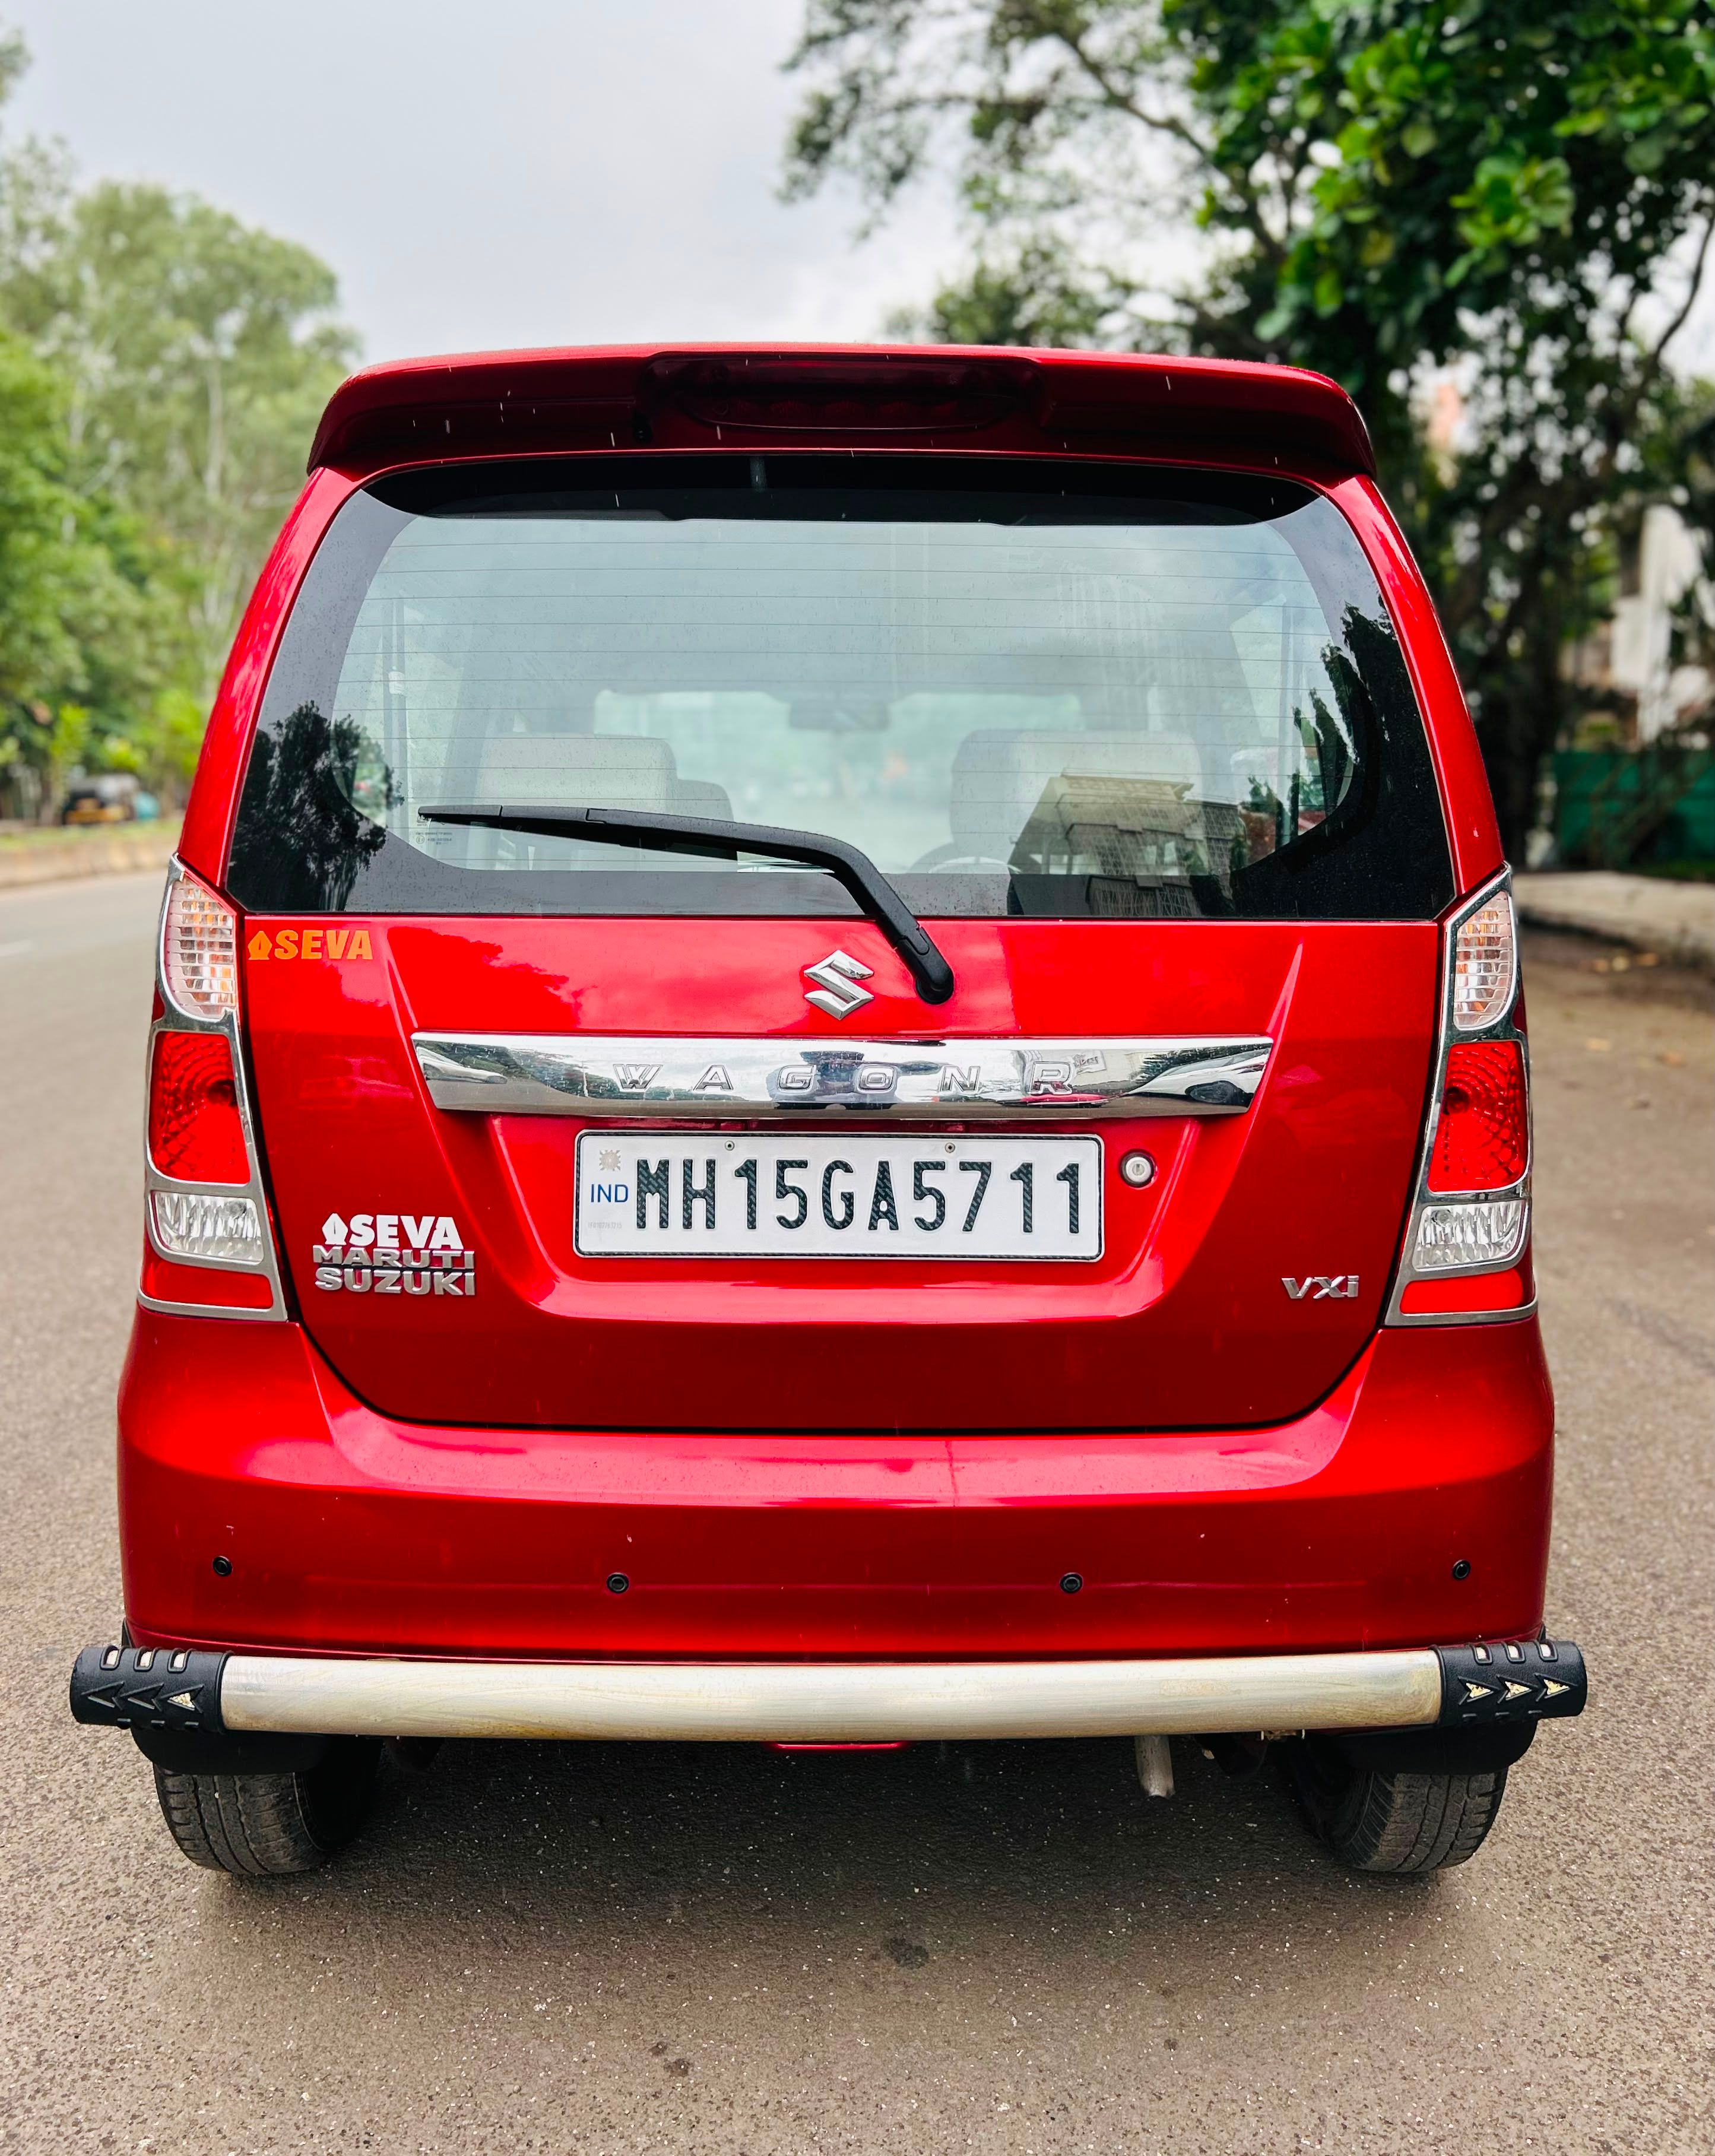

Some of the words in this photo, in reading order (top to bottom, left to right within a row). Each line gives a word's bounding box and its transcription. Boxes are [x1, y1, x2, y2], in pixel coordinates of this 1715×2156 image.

[274, 929, 373, 960] SEVA
[591, 1184, 629, 1203] IND
[636, 1158, 1079, 1234] MH15GA5711
[348, 1213, 464, 1250] SEVA
[312, 1244, 475, 1270] MARUTI
[315, 1267, 475, 1296] SUZUKI
